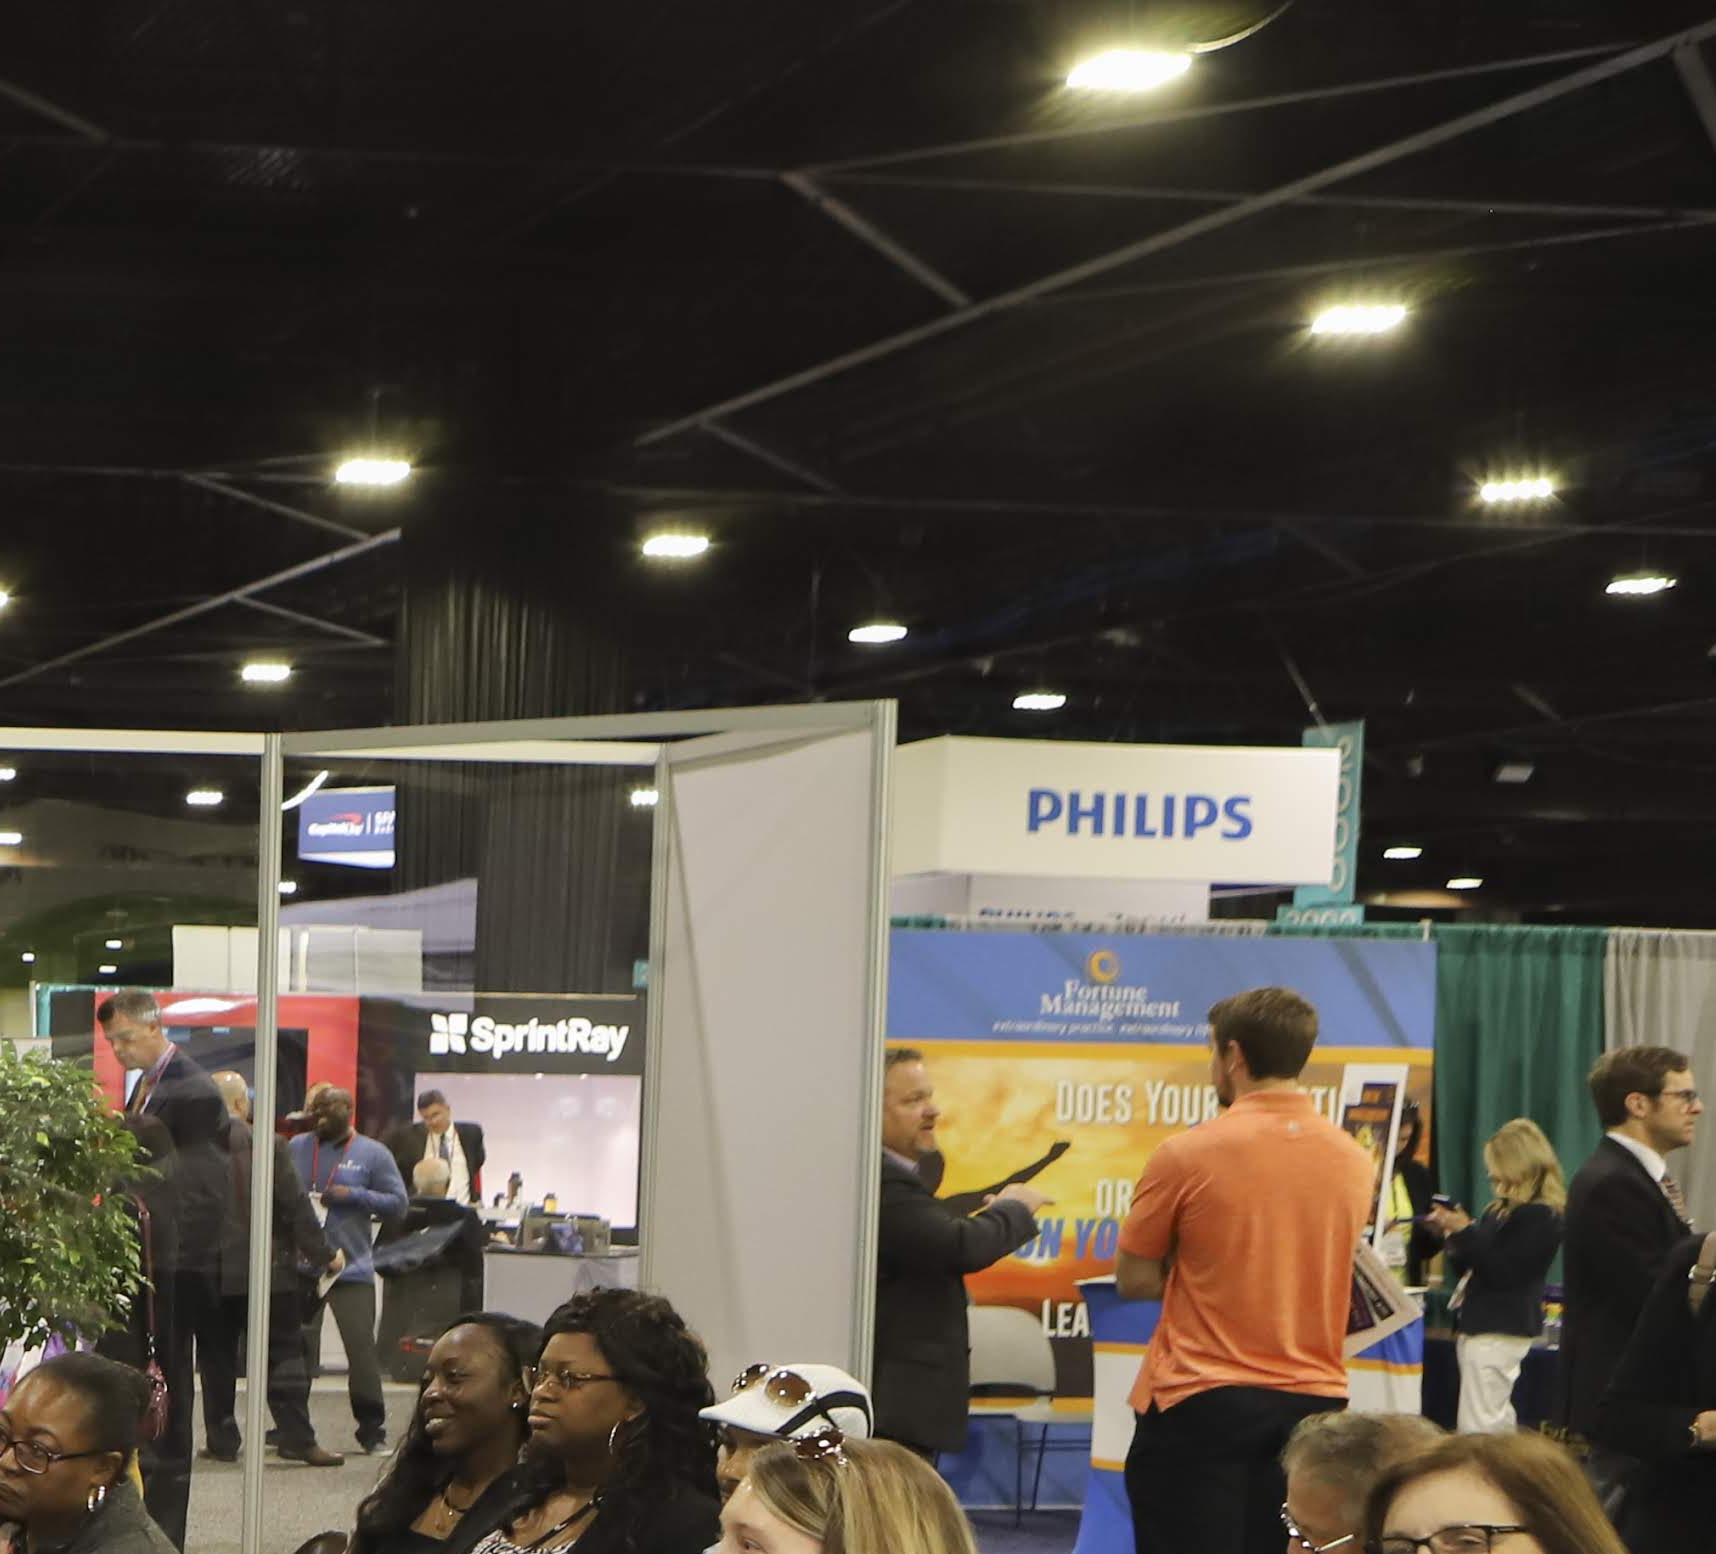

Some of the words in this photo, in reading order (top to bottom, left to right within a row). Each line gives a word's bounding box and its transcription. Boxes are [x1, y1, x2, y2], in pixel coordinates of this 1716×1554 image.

[1027, 788, 1253, 840] PHILIPS
[1039, 992, 1181, 1022] Management
[1064, 979, 1148, 1002] Fortune
[470, 1016, 630, 1062] SprintRay
[1055, 1079, 1134, 1124] DOES
[1144, 1080, 1221, 1126] YOUR
[1075, 1219, 1120, 1261] YO
[1041, 1297, 1092, 1338] LEA
